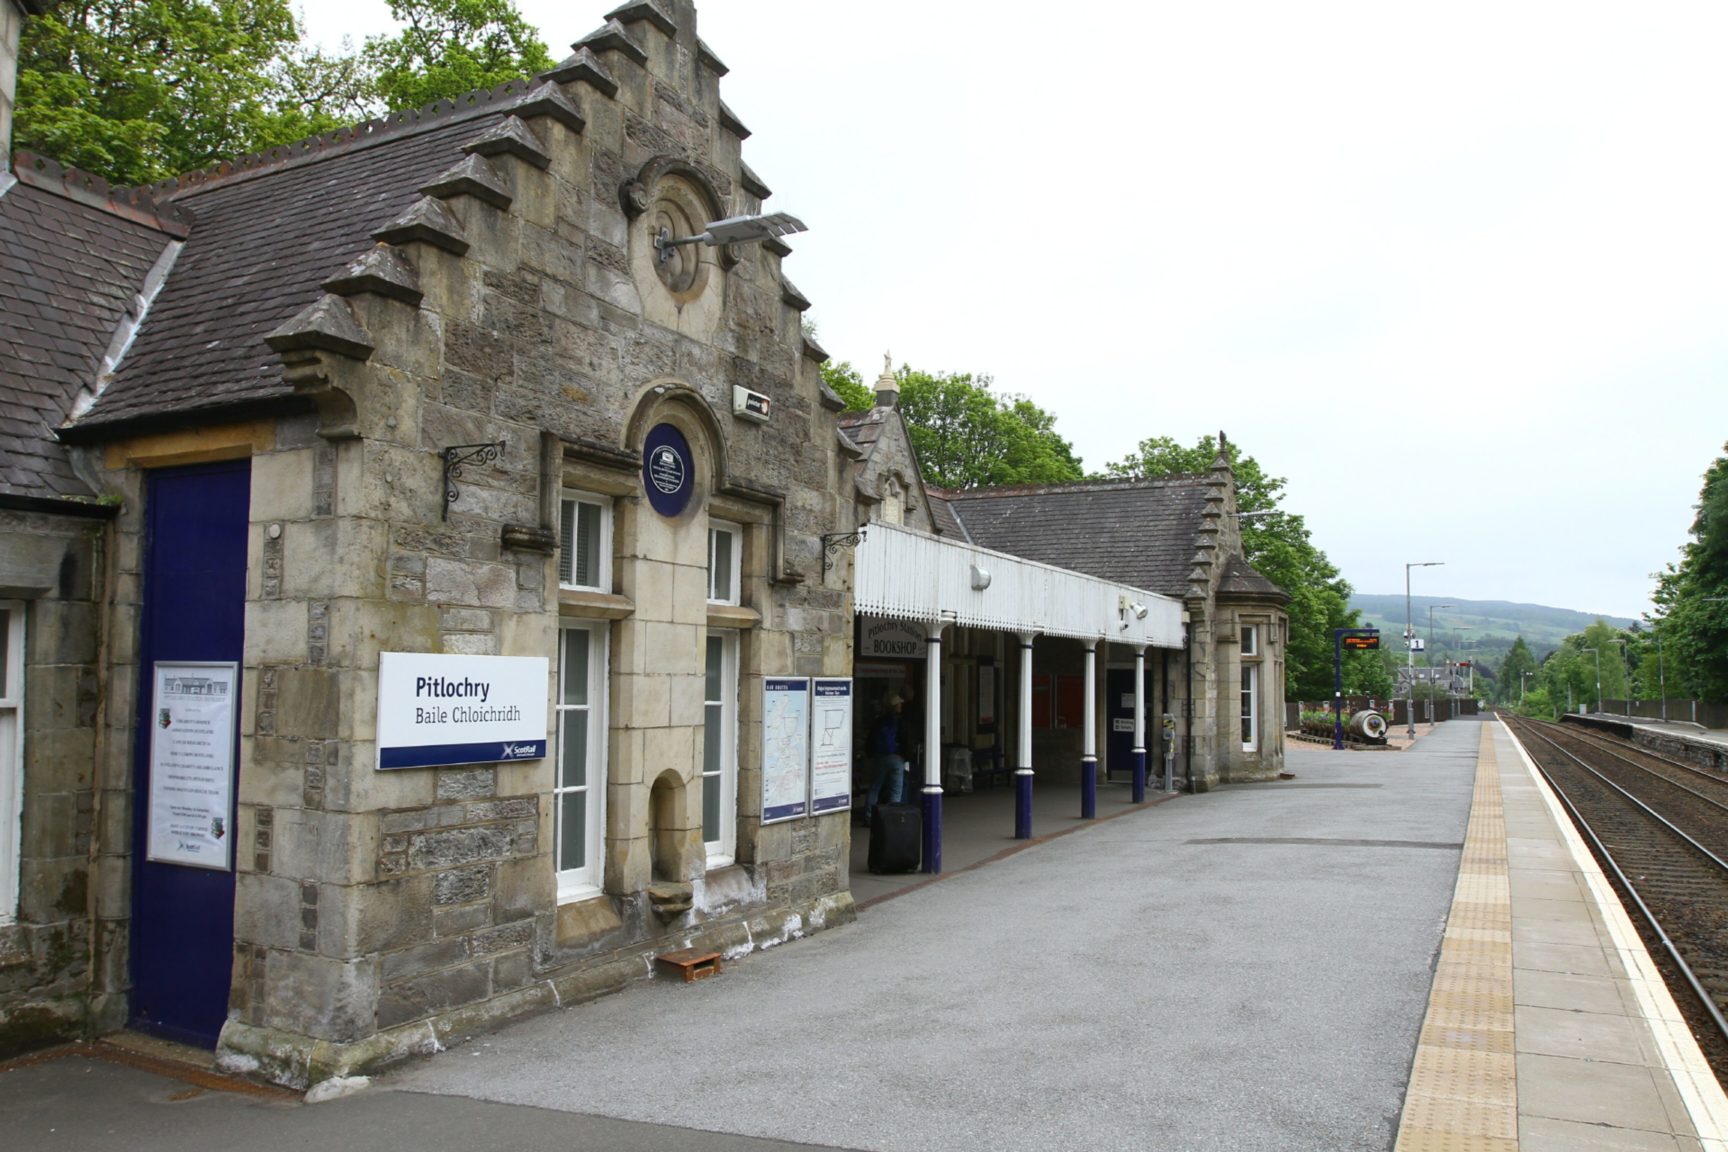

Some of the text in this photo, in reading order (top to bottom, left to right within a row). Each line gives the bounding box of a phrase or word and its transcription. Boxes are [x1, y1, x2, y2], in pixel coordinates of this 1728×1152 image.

[868, 621, 922, 641] Pitlochry Station
[873, 639, 917, 655] BOOKSHOP
[1414, 640, 1419, 648] 1
[416, 676, 490, 702] Pitlochry
[415, 705, 521, 724] Baile Chloichridh
